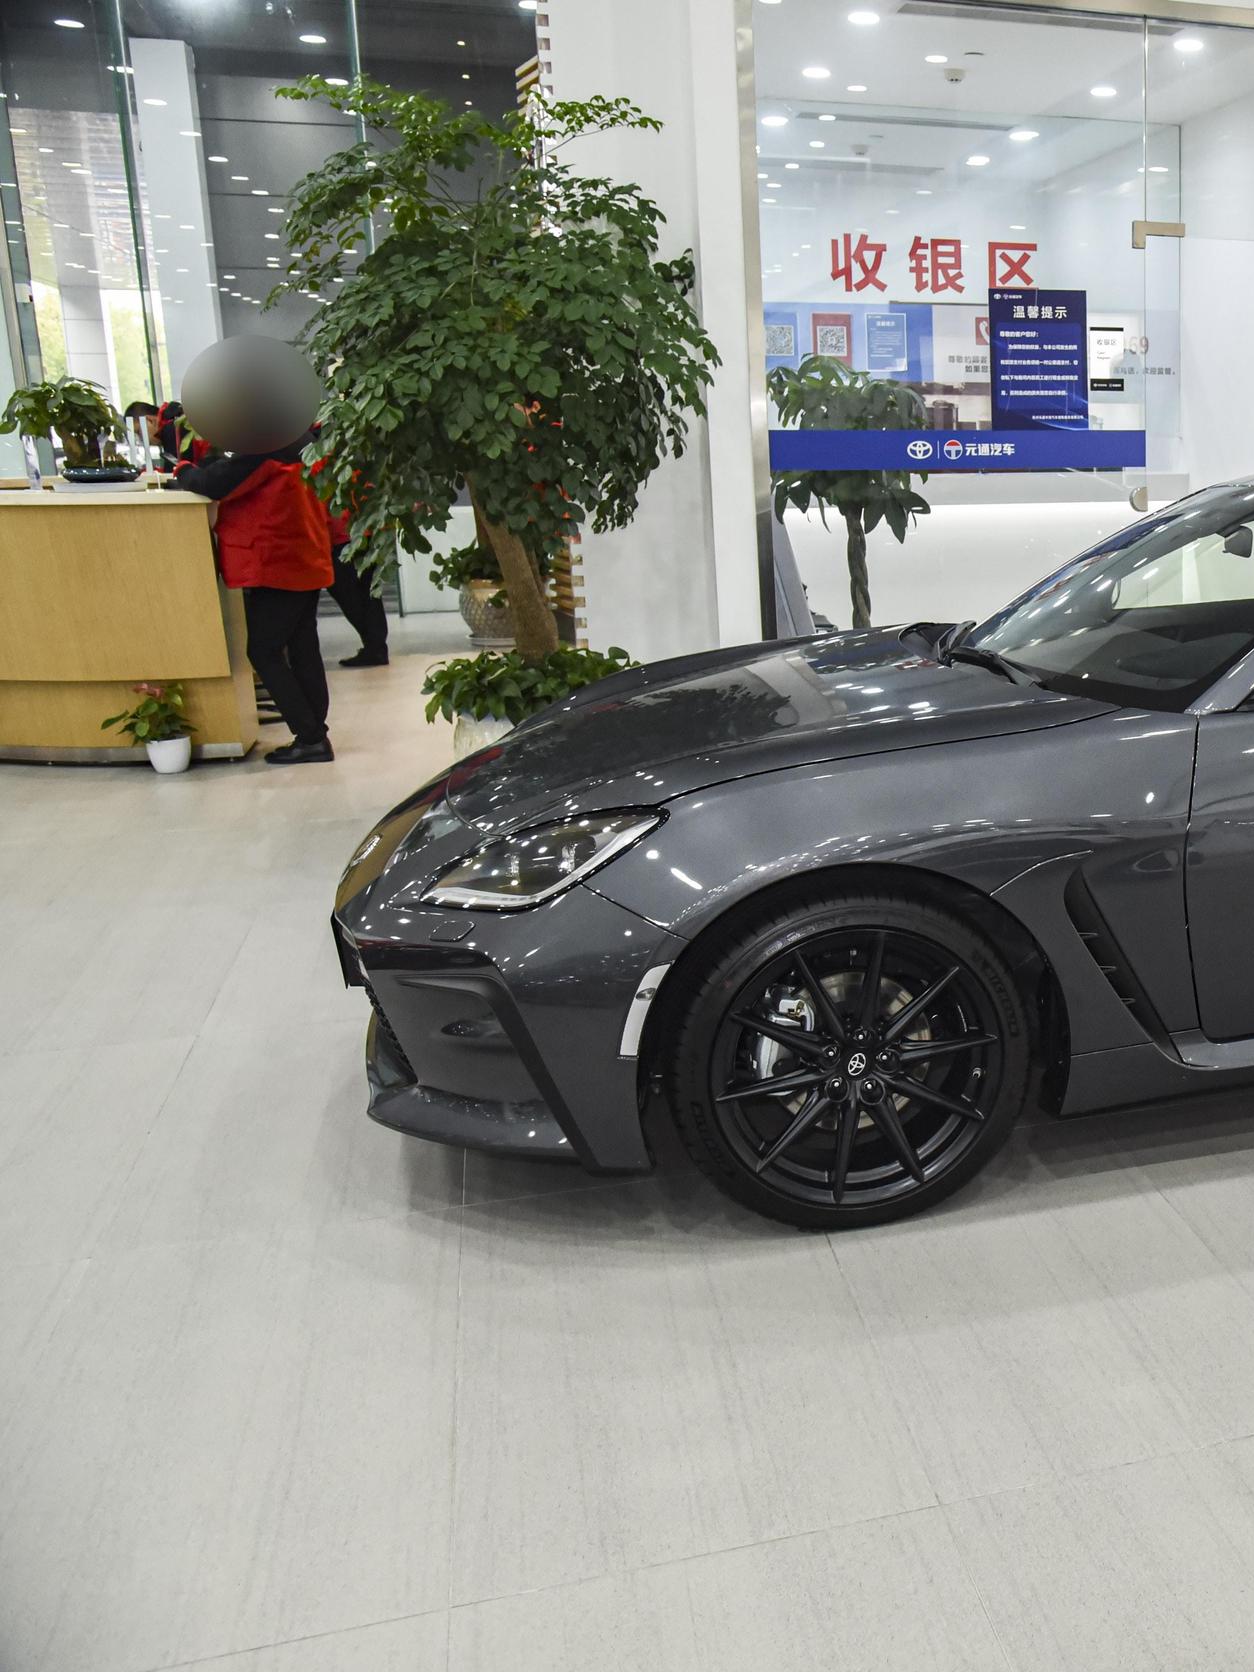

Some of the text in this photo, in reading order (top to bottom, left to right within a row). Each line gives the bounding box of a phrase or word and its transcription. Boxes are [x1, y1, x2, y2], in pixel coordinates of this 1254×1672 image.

[830, 233, 1039, 294] 收银区
[1013, 305, 1068, 319] 温馨提示
[965, 443, 1015, 456] 元通汽车
